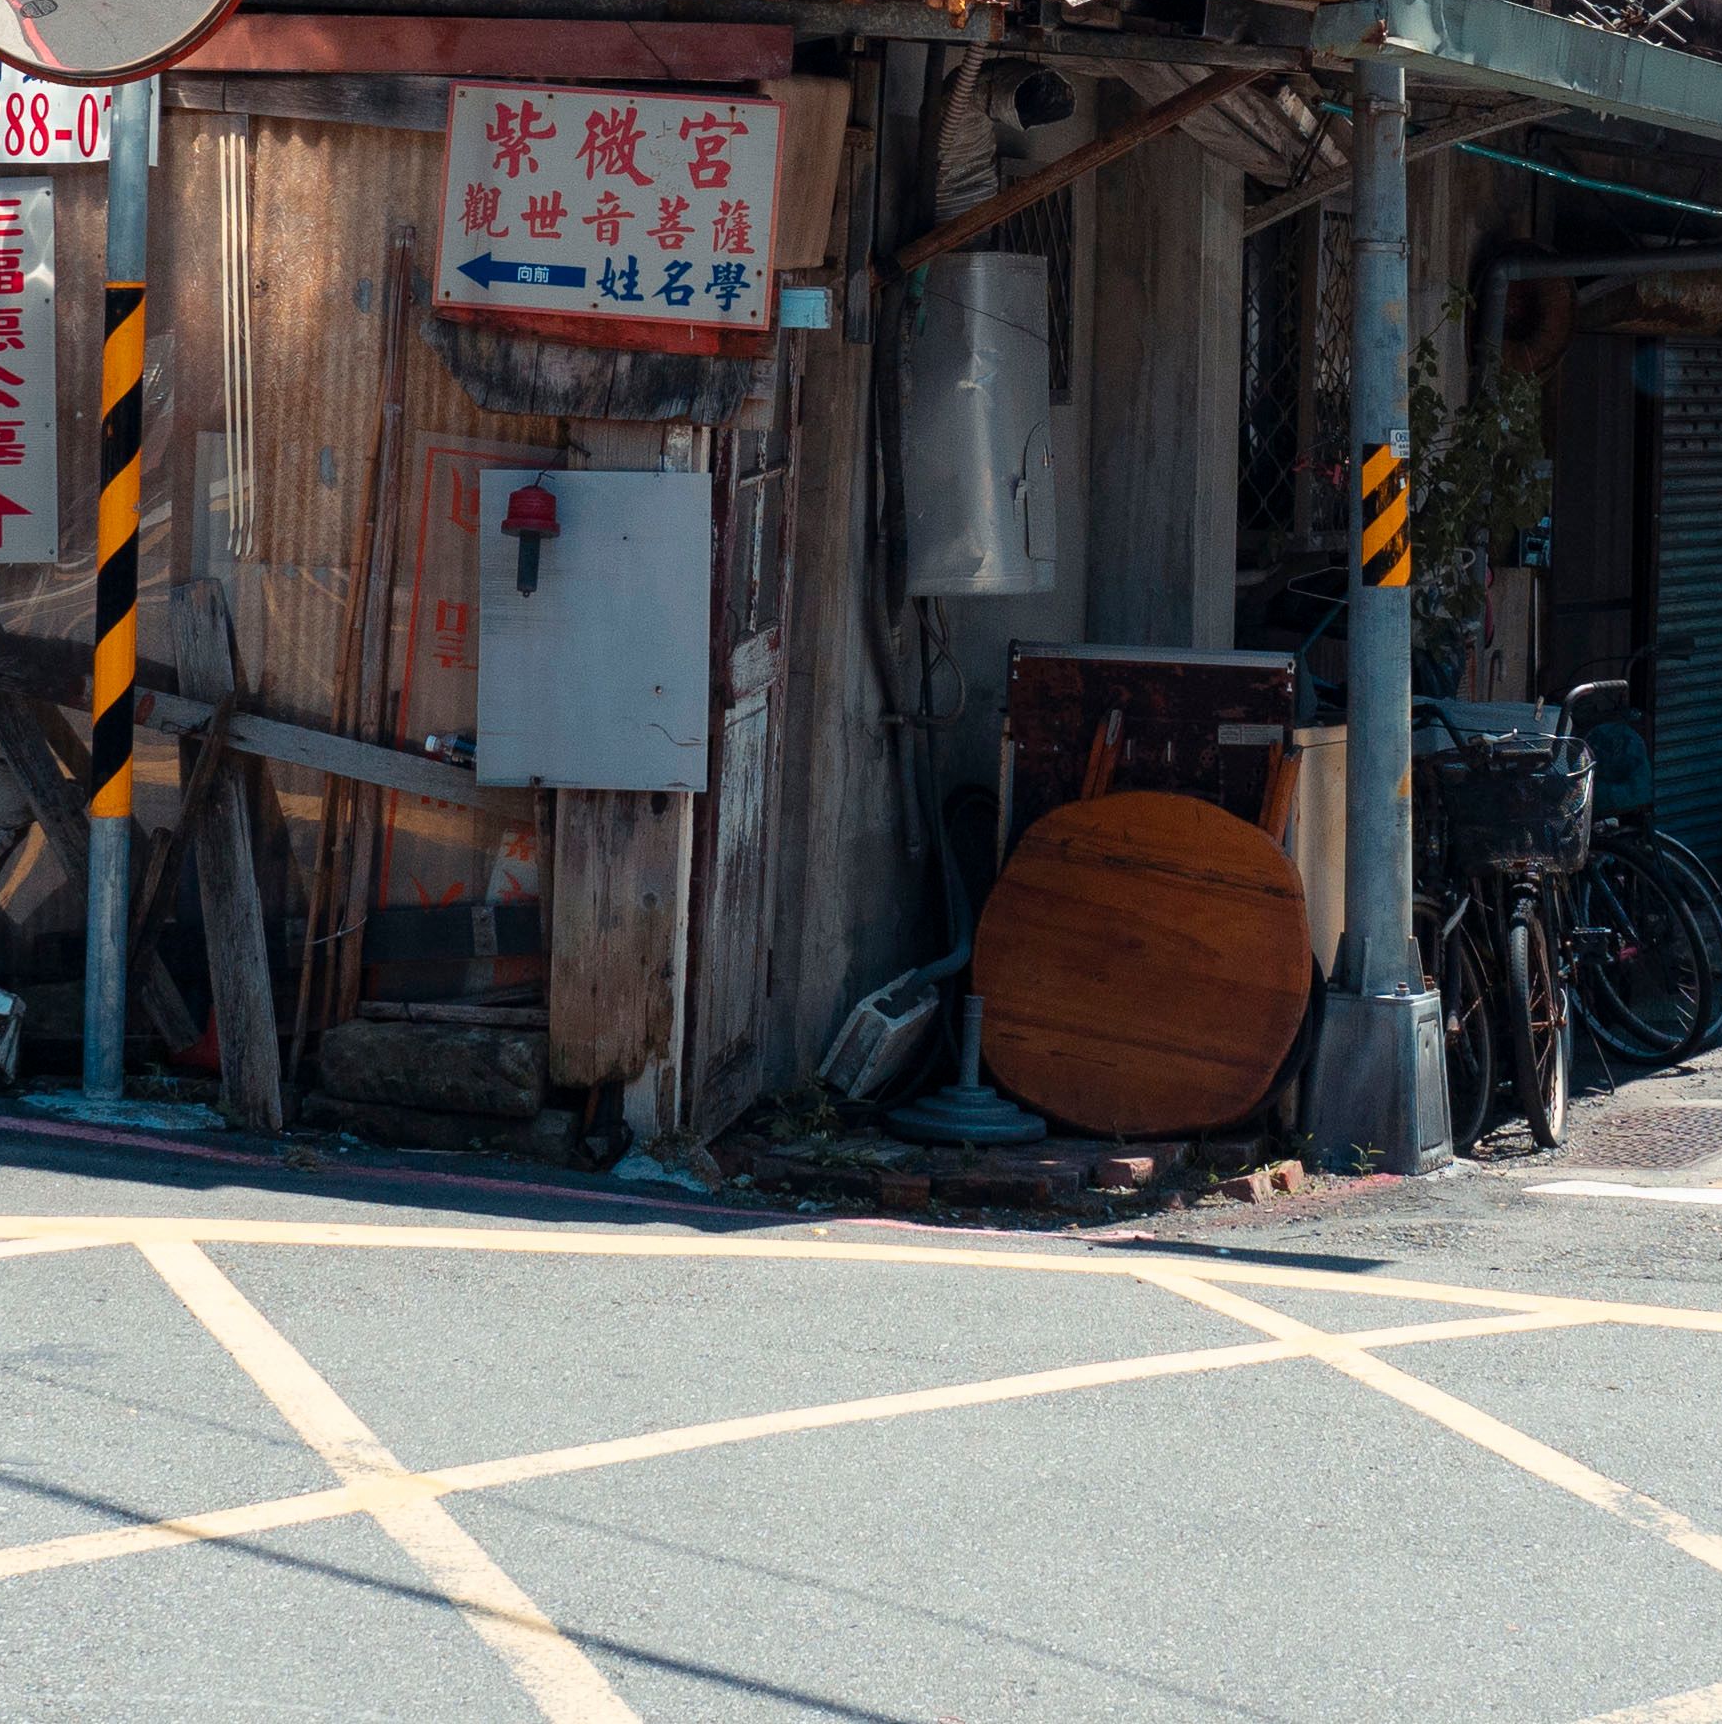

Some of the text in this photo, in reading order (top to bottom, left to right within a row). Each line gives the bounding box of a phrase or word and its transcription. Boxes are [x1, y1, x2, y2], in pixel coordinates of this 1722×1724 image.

[486, 100, 749, 190] 紫微宮
[458, 182, 755, 255] 觀世音菩薩
[518, 266, 549, 283] 向前
[597, 255, 750, 311] 姓名學
